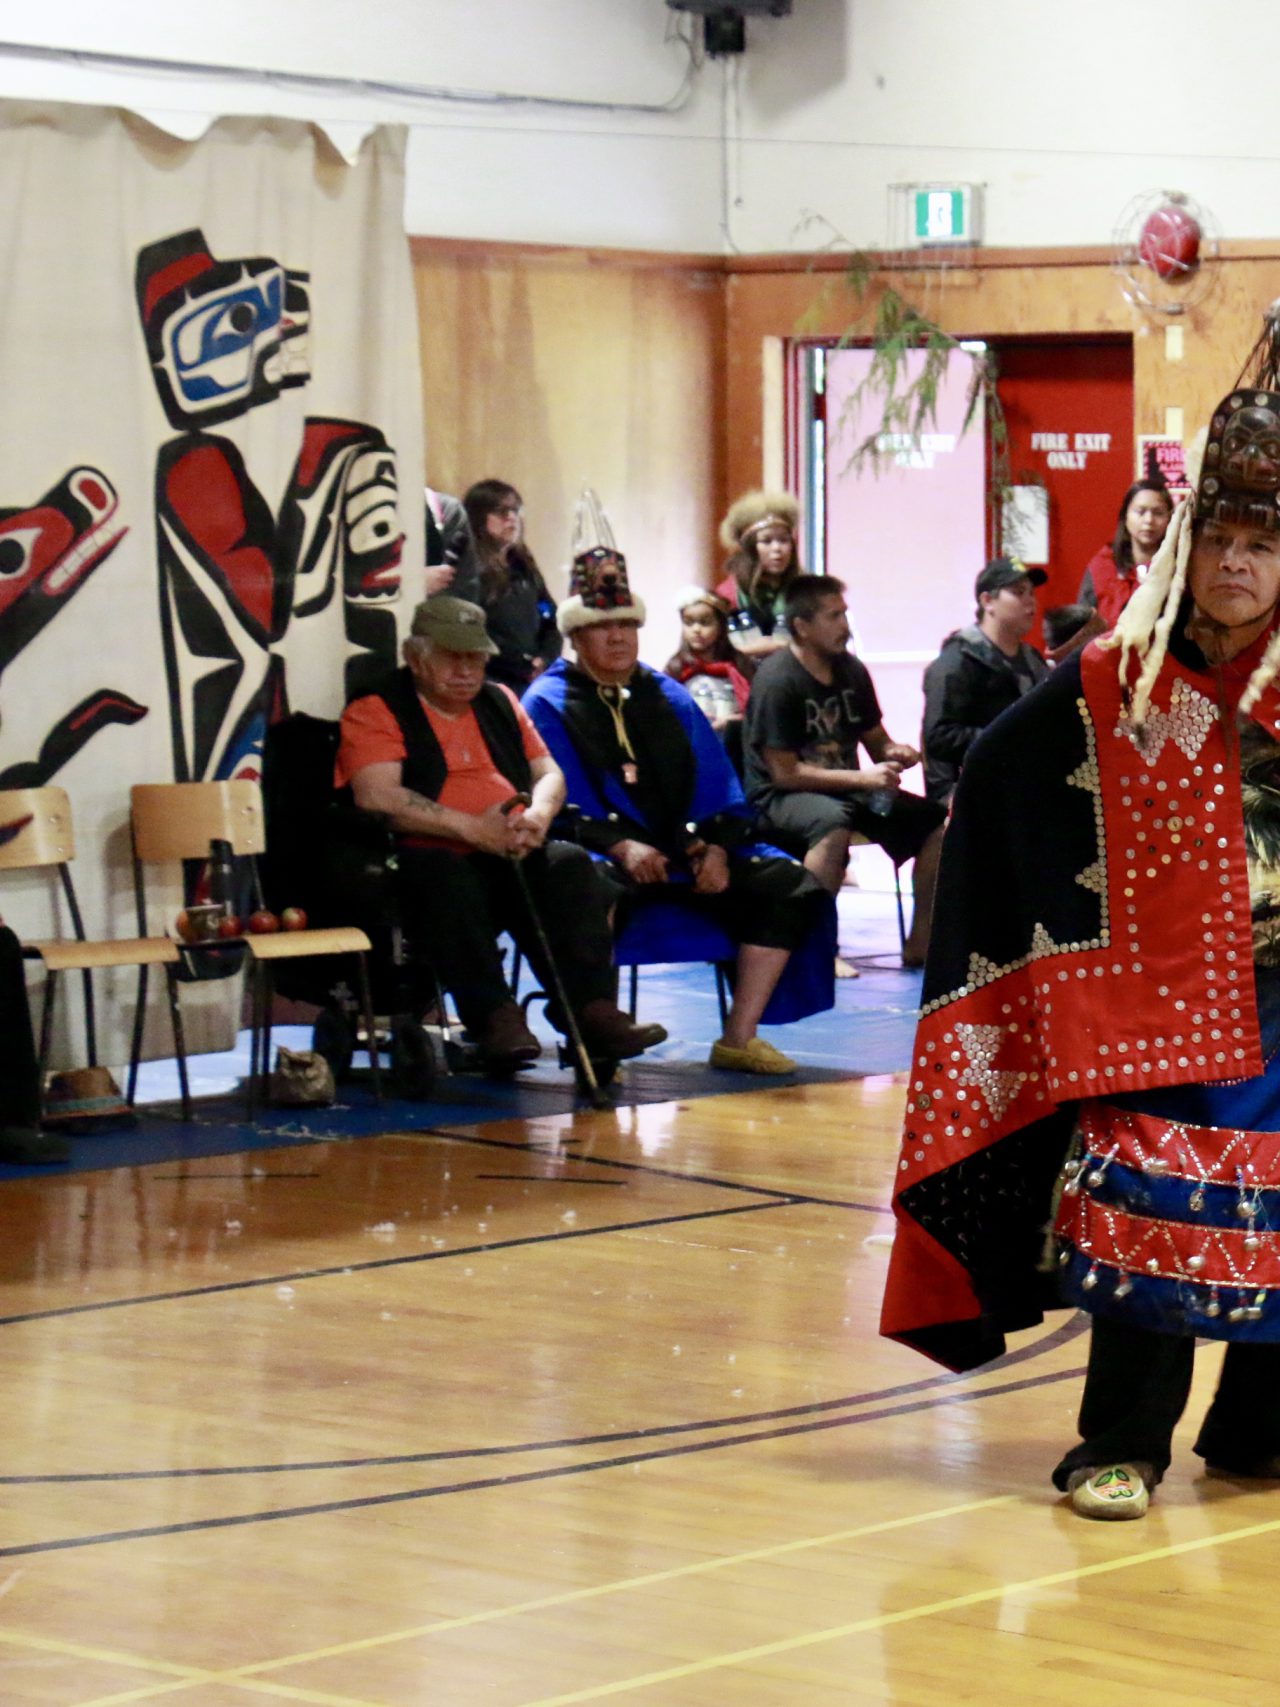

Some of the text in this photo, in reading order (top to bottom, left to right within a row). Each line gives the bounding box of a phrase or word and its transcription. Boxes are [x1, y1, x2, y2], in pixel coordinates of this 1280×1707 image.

[1031, 432, 1111, 452] FIRE EXIT
[1047, 451, 1087, 470] ONLY
